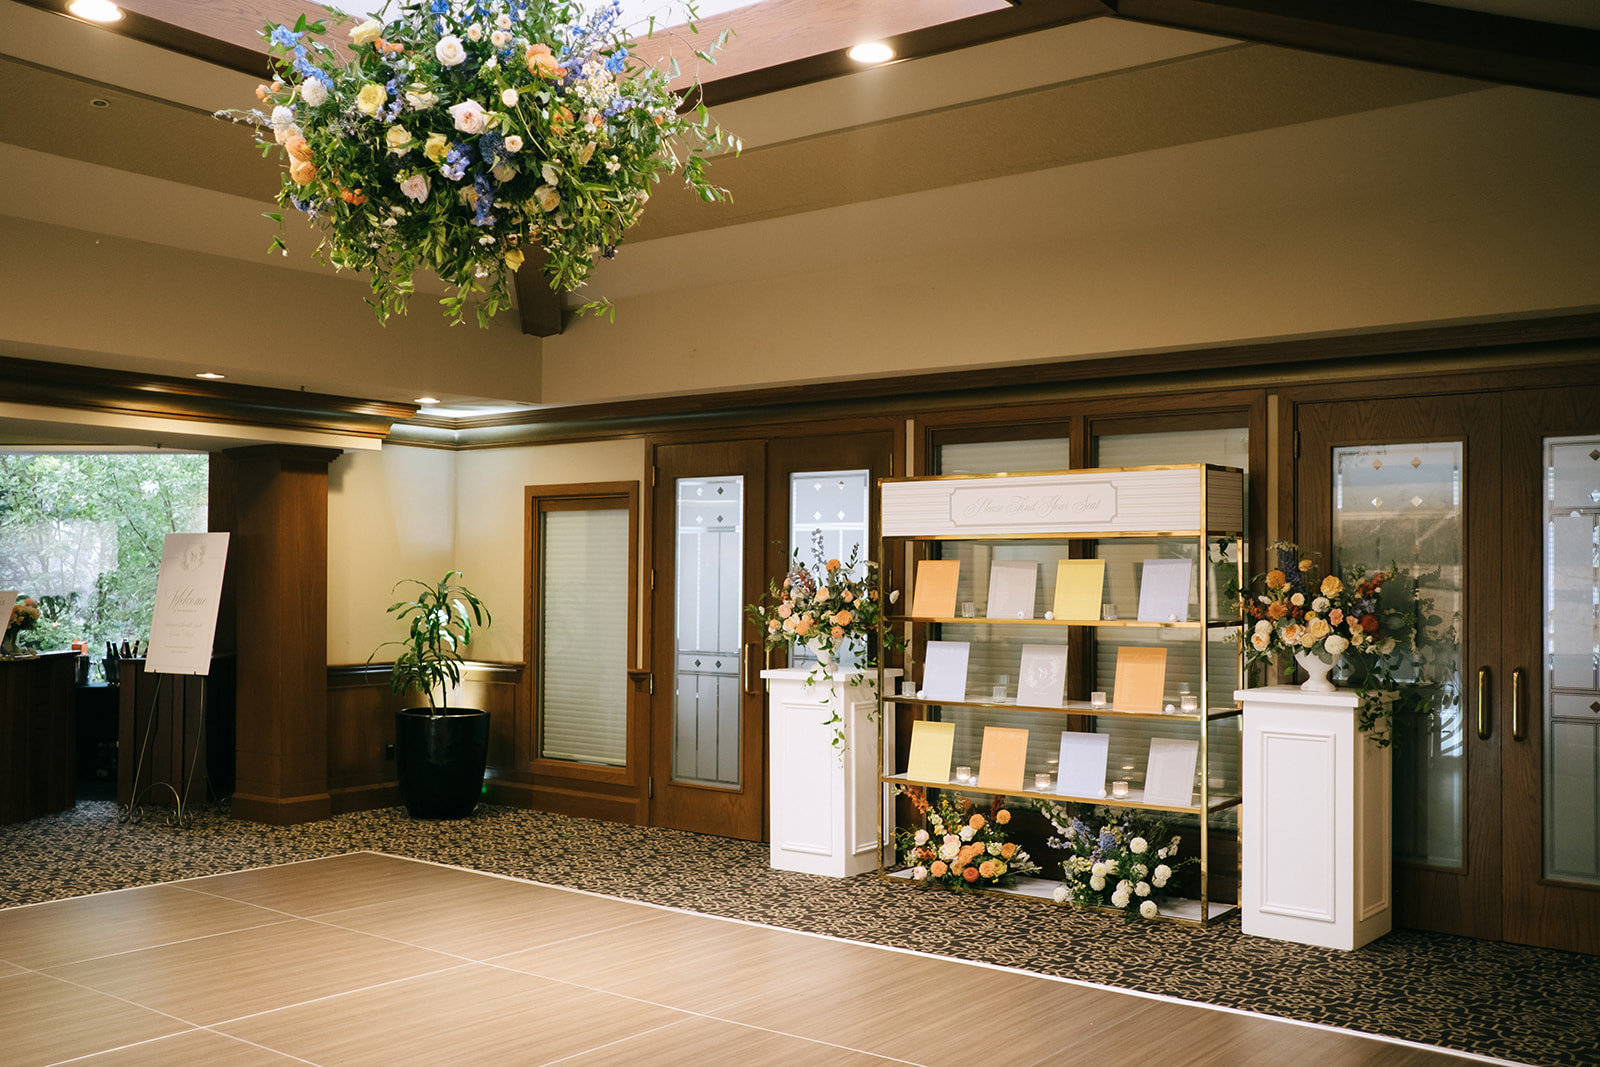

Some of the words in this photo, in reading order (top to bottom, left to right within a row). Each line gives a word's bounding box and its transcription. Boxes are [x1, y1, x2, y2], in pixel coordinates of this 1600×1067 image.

[965, 496, 1003, 518] Please
[1007, 495, 1039, 514] Find
[1039, 494, 1068, 518] Your
[1072, 493, 1102, 513] Seat
[165, 584, 207, 609] Welcome
